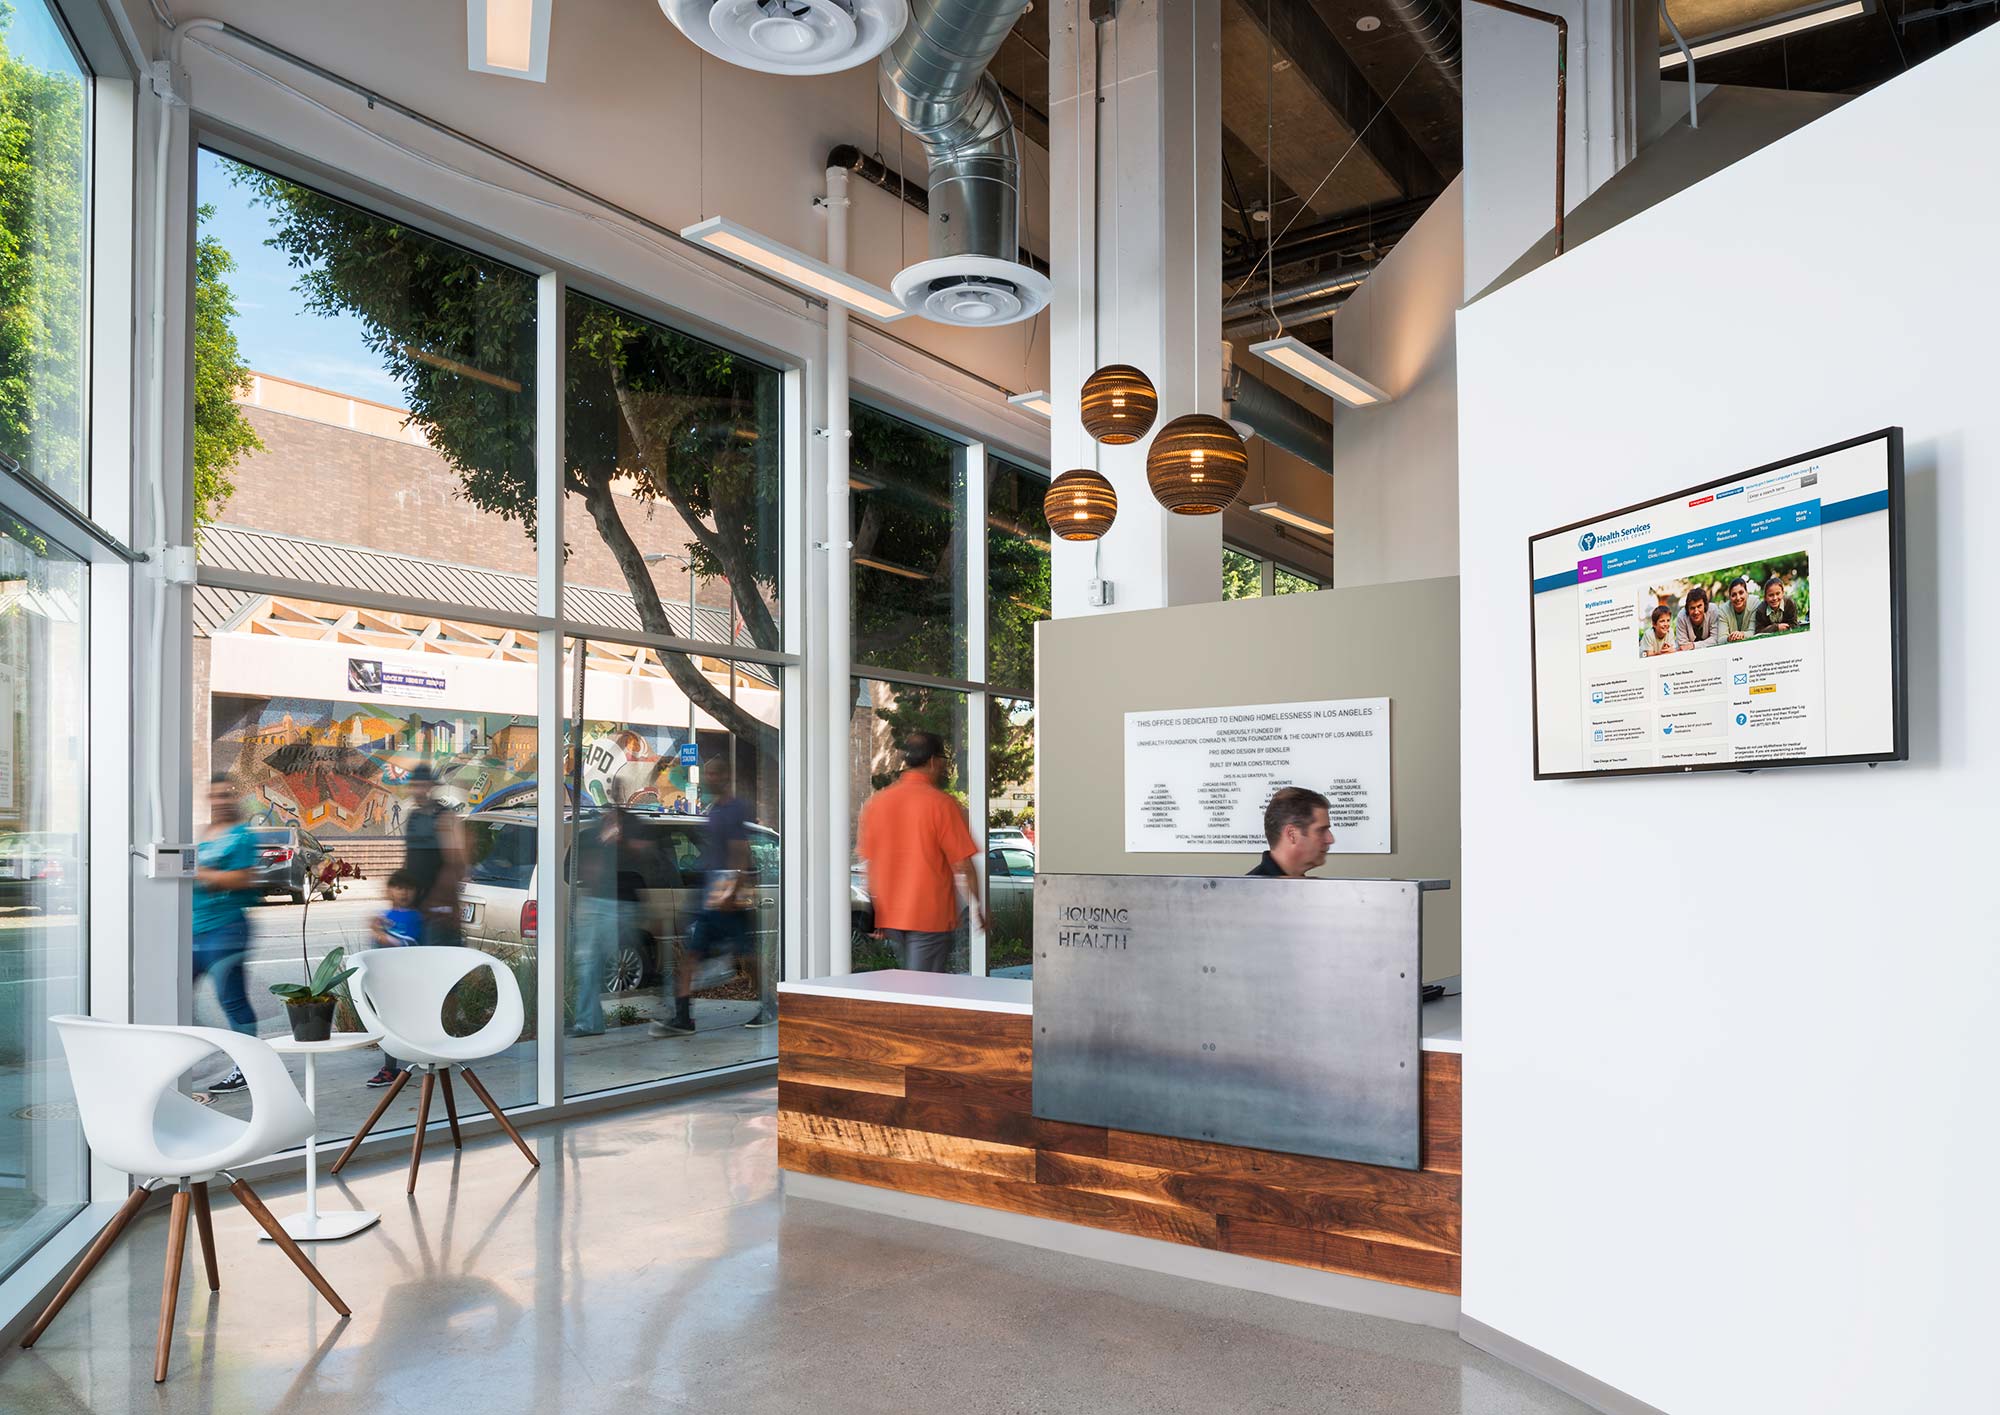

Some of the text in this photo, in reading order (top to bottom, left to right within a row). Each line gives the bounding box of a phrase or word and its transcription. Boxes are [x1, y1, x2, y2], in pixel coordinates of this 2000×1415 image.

[1597, 523, 1651, 543] Health Services
[1608, 536, 1629, 545] ANGELES
[1631, 530, 1651, 539] COUNTY
[1182, 716, 1218, 725] DEDICATED
[1256, 712, 1312, 721] HOMELESSNESS
[1338, 708, 1373, 717] ANGELES
[474, 772, 488, 790] 1292
[1059, 906, 1128, 922] HOUSING
[1059, 932, 1126, 950] HEALTH
